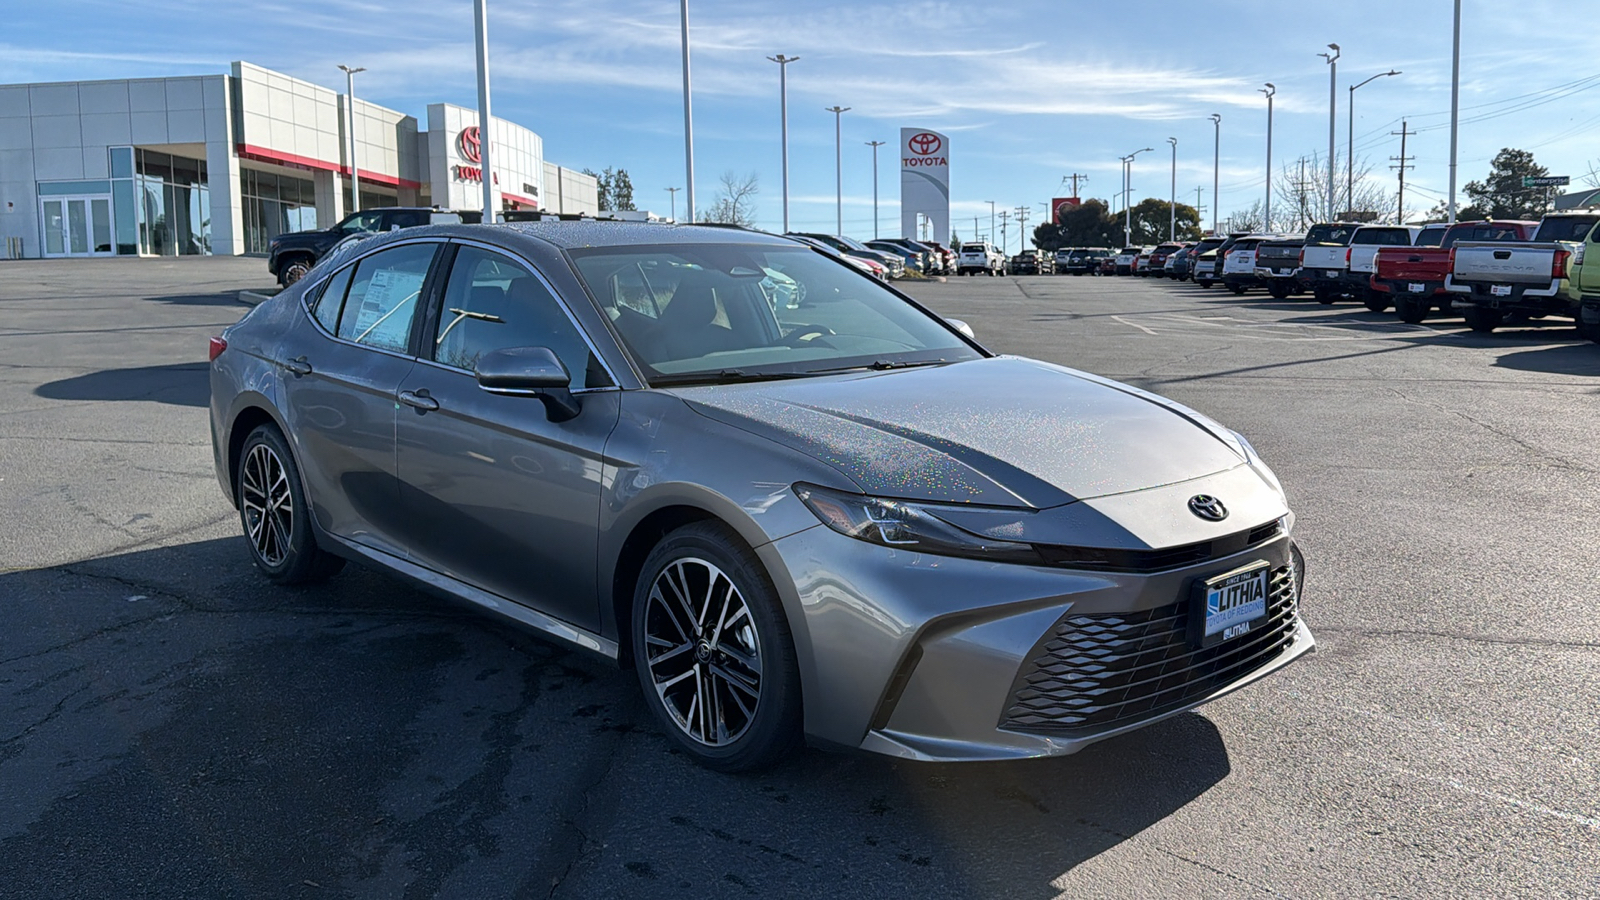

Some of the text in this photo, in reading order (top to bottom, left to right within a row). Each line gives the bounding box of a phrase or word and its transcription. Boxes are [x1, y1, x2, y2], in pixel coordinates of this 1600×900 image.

[903, 157, 947, 167] TOYOTA
[455, 164, 499, 185] TOYA
[1225, 575, 1240, 586] SINCE
[1219, 578, 1264, 613] LITHIA
[1206, 600, 1264, 628] TOYOTA OF REDDING
[1229, 621, 1250, 638] LITHIA
